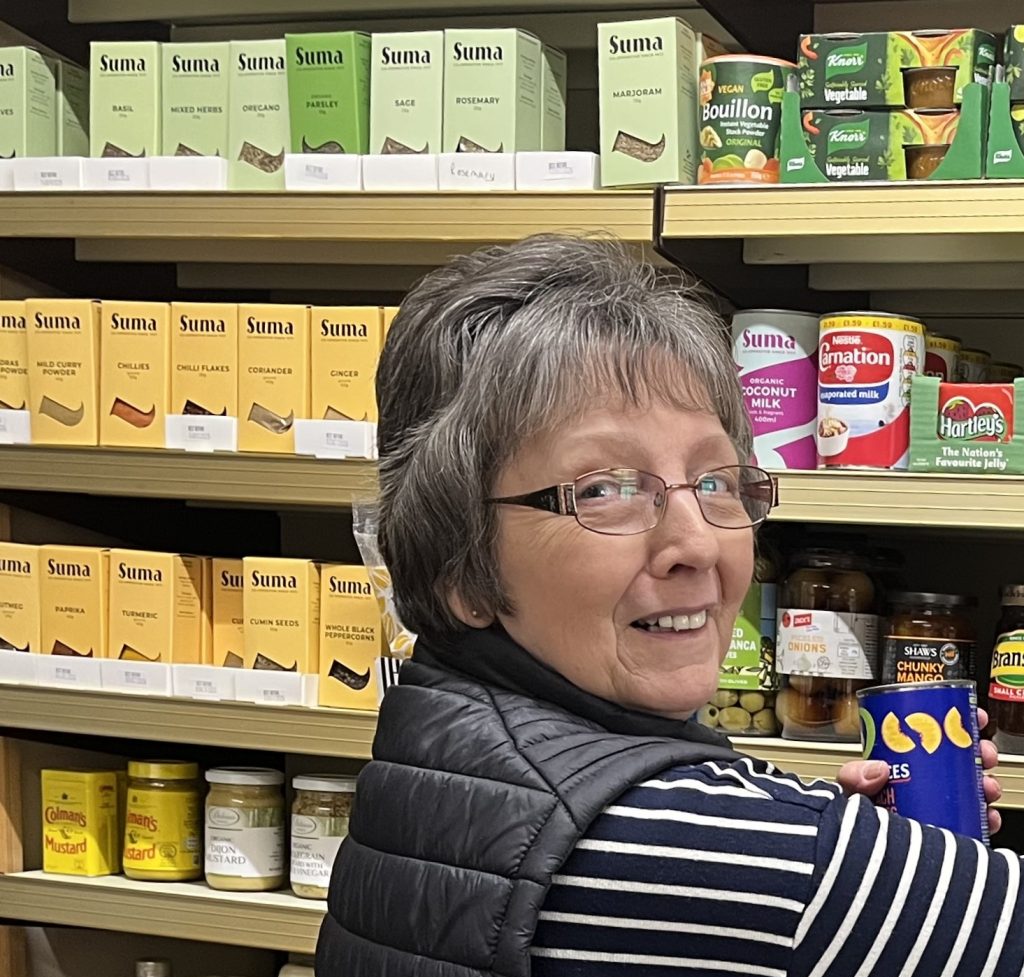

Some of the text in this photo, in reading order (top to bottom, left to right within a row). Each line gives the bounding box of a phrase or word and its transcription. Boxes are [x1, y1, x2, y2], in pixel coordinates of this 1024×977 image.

[609, 35, 663, 54] Suma
[382, 47, 430, 64] Suma
[827, 53, 864, 67] Knorr
[172, 55, 219, 73] Suma
[613, 88, 662, 98] MARJORAM
[718, 85, 744, 93] VEGAN
[456, 97, 499, 105] ROSEMARY
[824, 87, 867, 104] Vegetable
[242, 104, 280, 112] OREGANO
[306, 101, 338, 109] PARSLEY
[395, 99, 415, 107] SAGE
[112, 105, 134, 113] BASIL
[197, 106, 222, 114] HERBS
[703, 98, 773, 121] Bouillon
[829, 129, 866, 143] Knorr
[726, 139, 762, 147] ORIGINAL
[111, 313, 157, 332] Suma
[321, 319, 368, 338] Suma
[820, 342, 891, 372] Carnation
[36, 361, 82, 370] MILD CURRY
[117, 362, 150, 370] CHILLIES
[176, 364, 230, 372] CHILLI FLAKES
[248, 367, 293, 375] CORIANDER
[330, 370, 359, 378] GINGER
[749, 377, 785, 385] ORGANIC
[751, 398, 781, 409] MILK
[941, 413, 1004, 440] Hartley's
[942, 447, 1003, 458] The Nation's
[935, 457, 983, 468] Favourite
[47, 558, 91, 577] Suma
[329, 576, 371, 595] Suma
[55, 606, 85, 614] PAPRIKA
[122, 611, 158, 620] TURMERIC
[250, 618, 299, 627] CUMIN SEEDS
[325, 625, 375, 634] WHOLE BLACK
[324, 632, 375, 642] PEPPERCORNS
[788, 642, 827, 653] ONIONS
[897, 661, 945, 673] CHUNKY
[897, 672, 944, 683] MANGO
[45, 806, 87, 827] Colman's
[45, 837, 87, 854] Mustard
